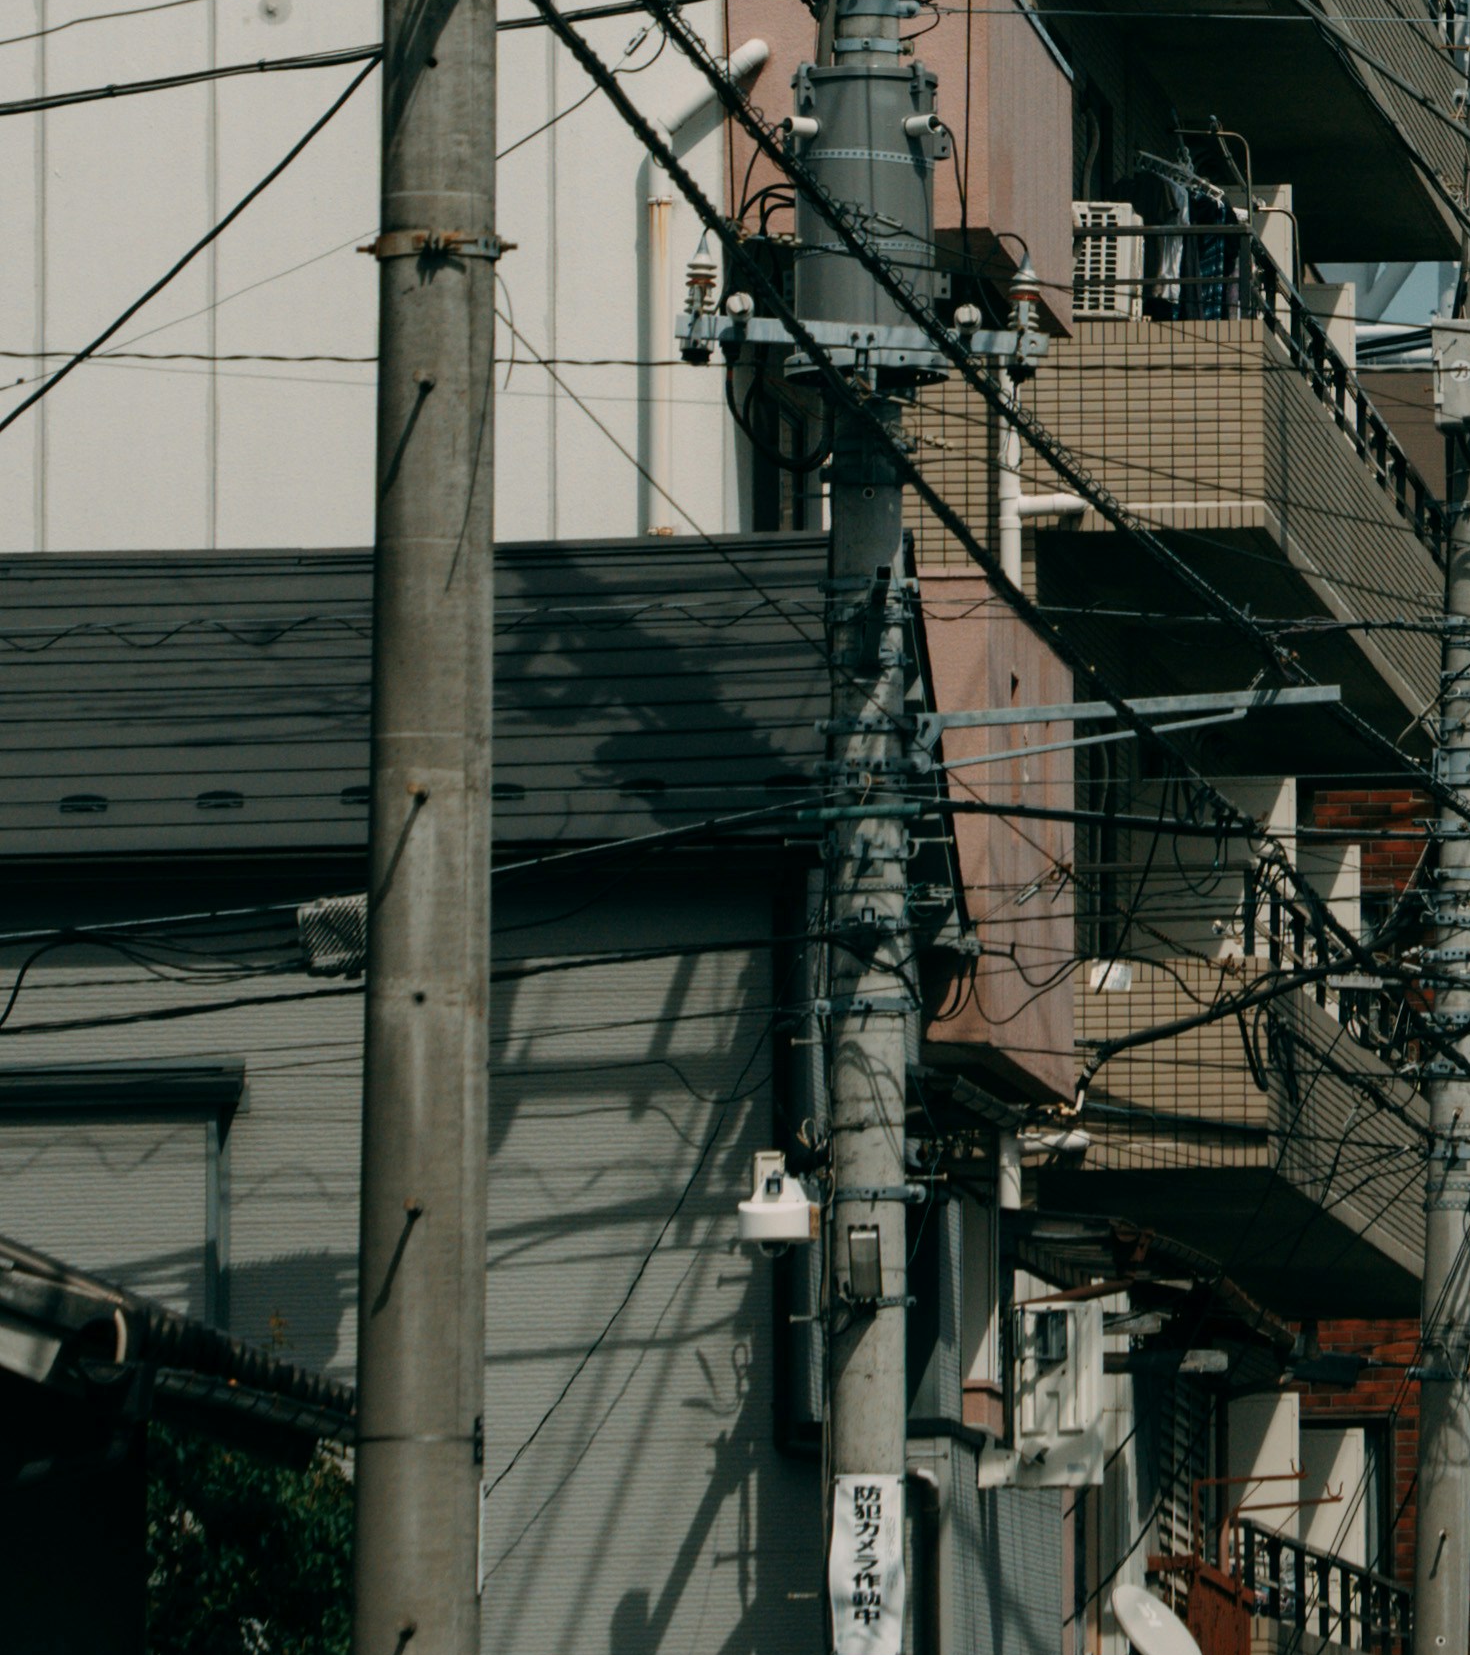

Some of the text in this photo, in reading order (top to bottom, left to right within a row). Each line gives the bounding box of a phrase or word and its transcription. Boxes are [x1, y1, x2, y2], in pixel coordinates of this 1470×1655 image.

[853, 1485, 882, 1625] 防犯カメラ作動中
